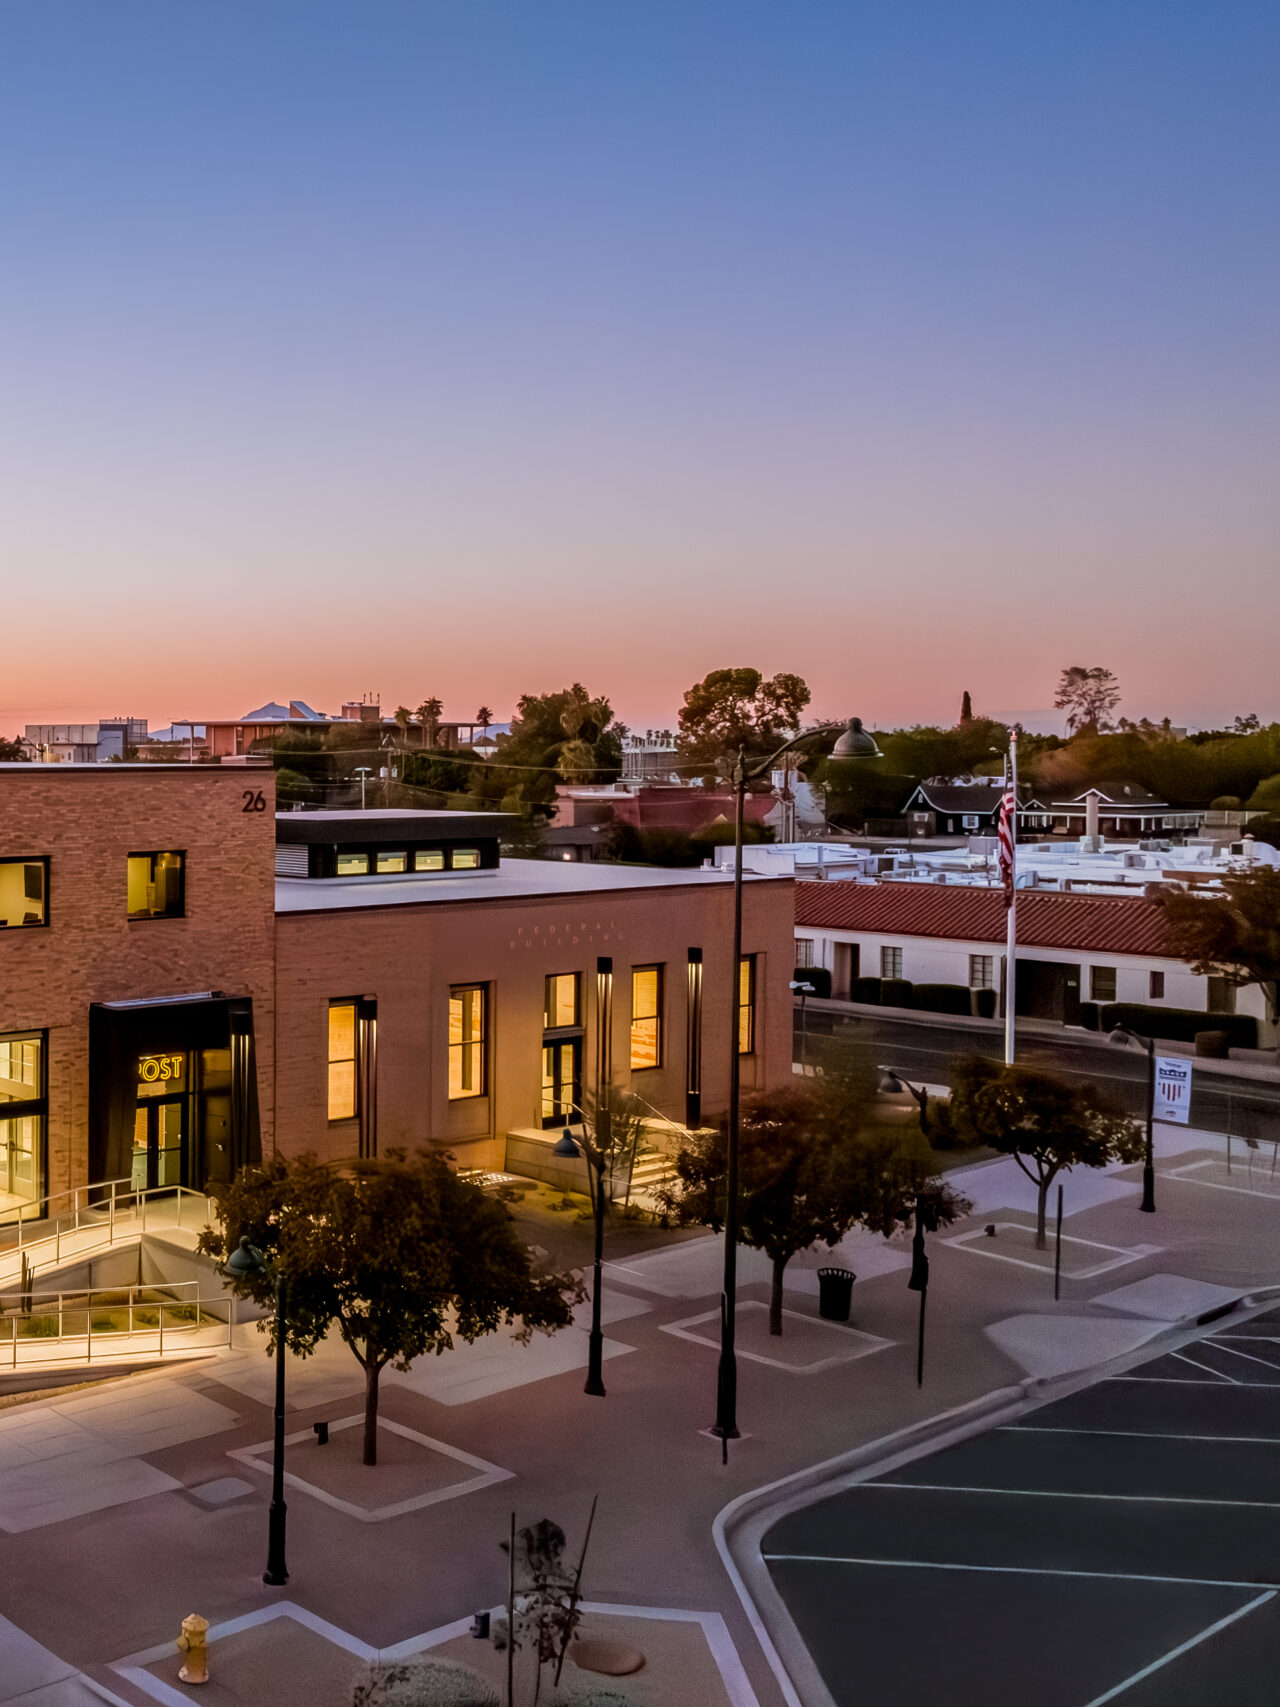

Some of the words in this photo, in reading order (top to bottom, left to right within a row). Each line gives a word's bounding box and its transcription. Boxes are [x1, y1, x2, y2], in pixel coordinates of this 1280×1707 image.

[242, 790, 267, 813] 26
[518, 921, 615, 936] FEDERAL
[510, 933, 624, 949] BUILDING
[139, 1057, 183, 1082] OST
